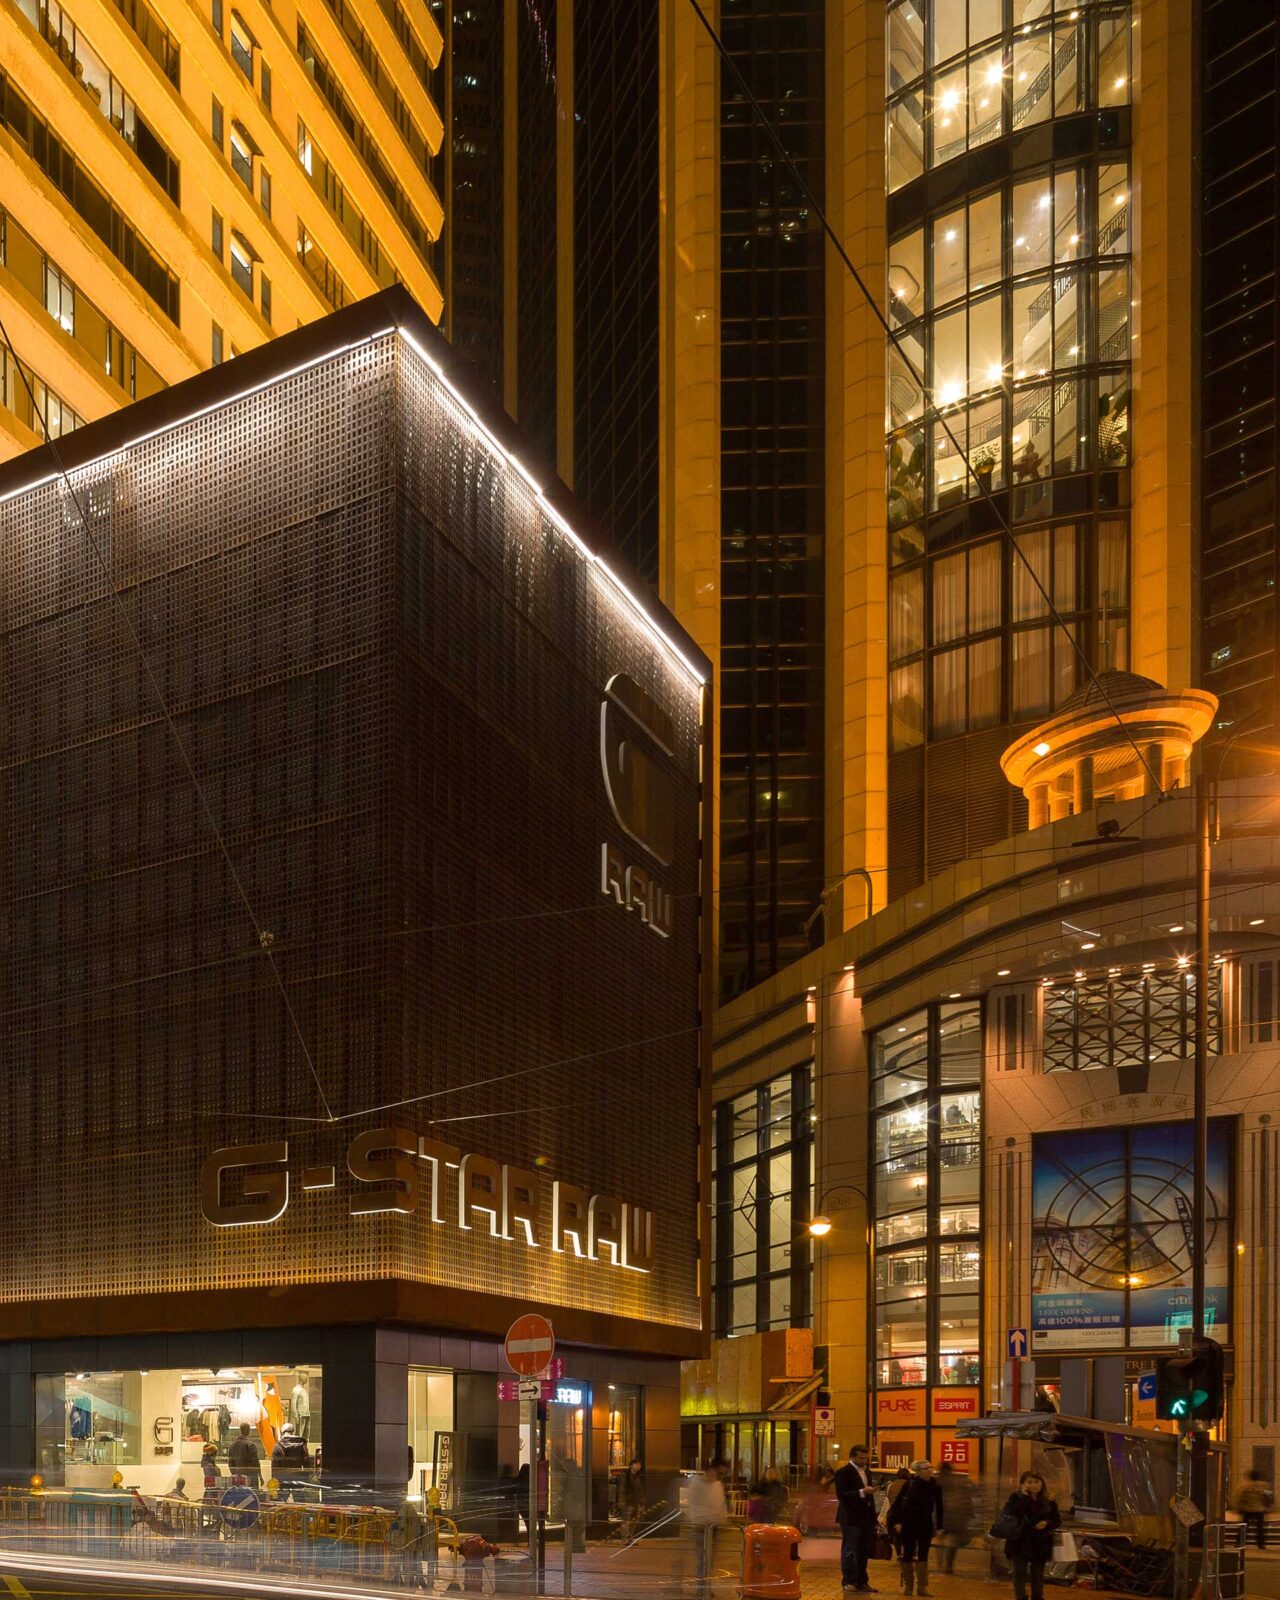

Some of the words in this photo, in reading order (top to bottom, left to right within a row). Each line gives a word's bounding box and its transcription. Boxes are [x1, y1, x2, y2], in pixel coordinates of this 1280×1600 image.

[601, 842, 672, 938] RAW
[200, 1129, 541, 1247] G-STAR
[552, 1180, 657, 1273] RAW
[878, 1398, 917, 1413] PURE
[938, 1401, 971, 1411] ESPRIT
[885, 1454, 910, 1468] MUJI
